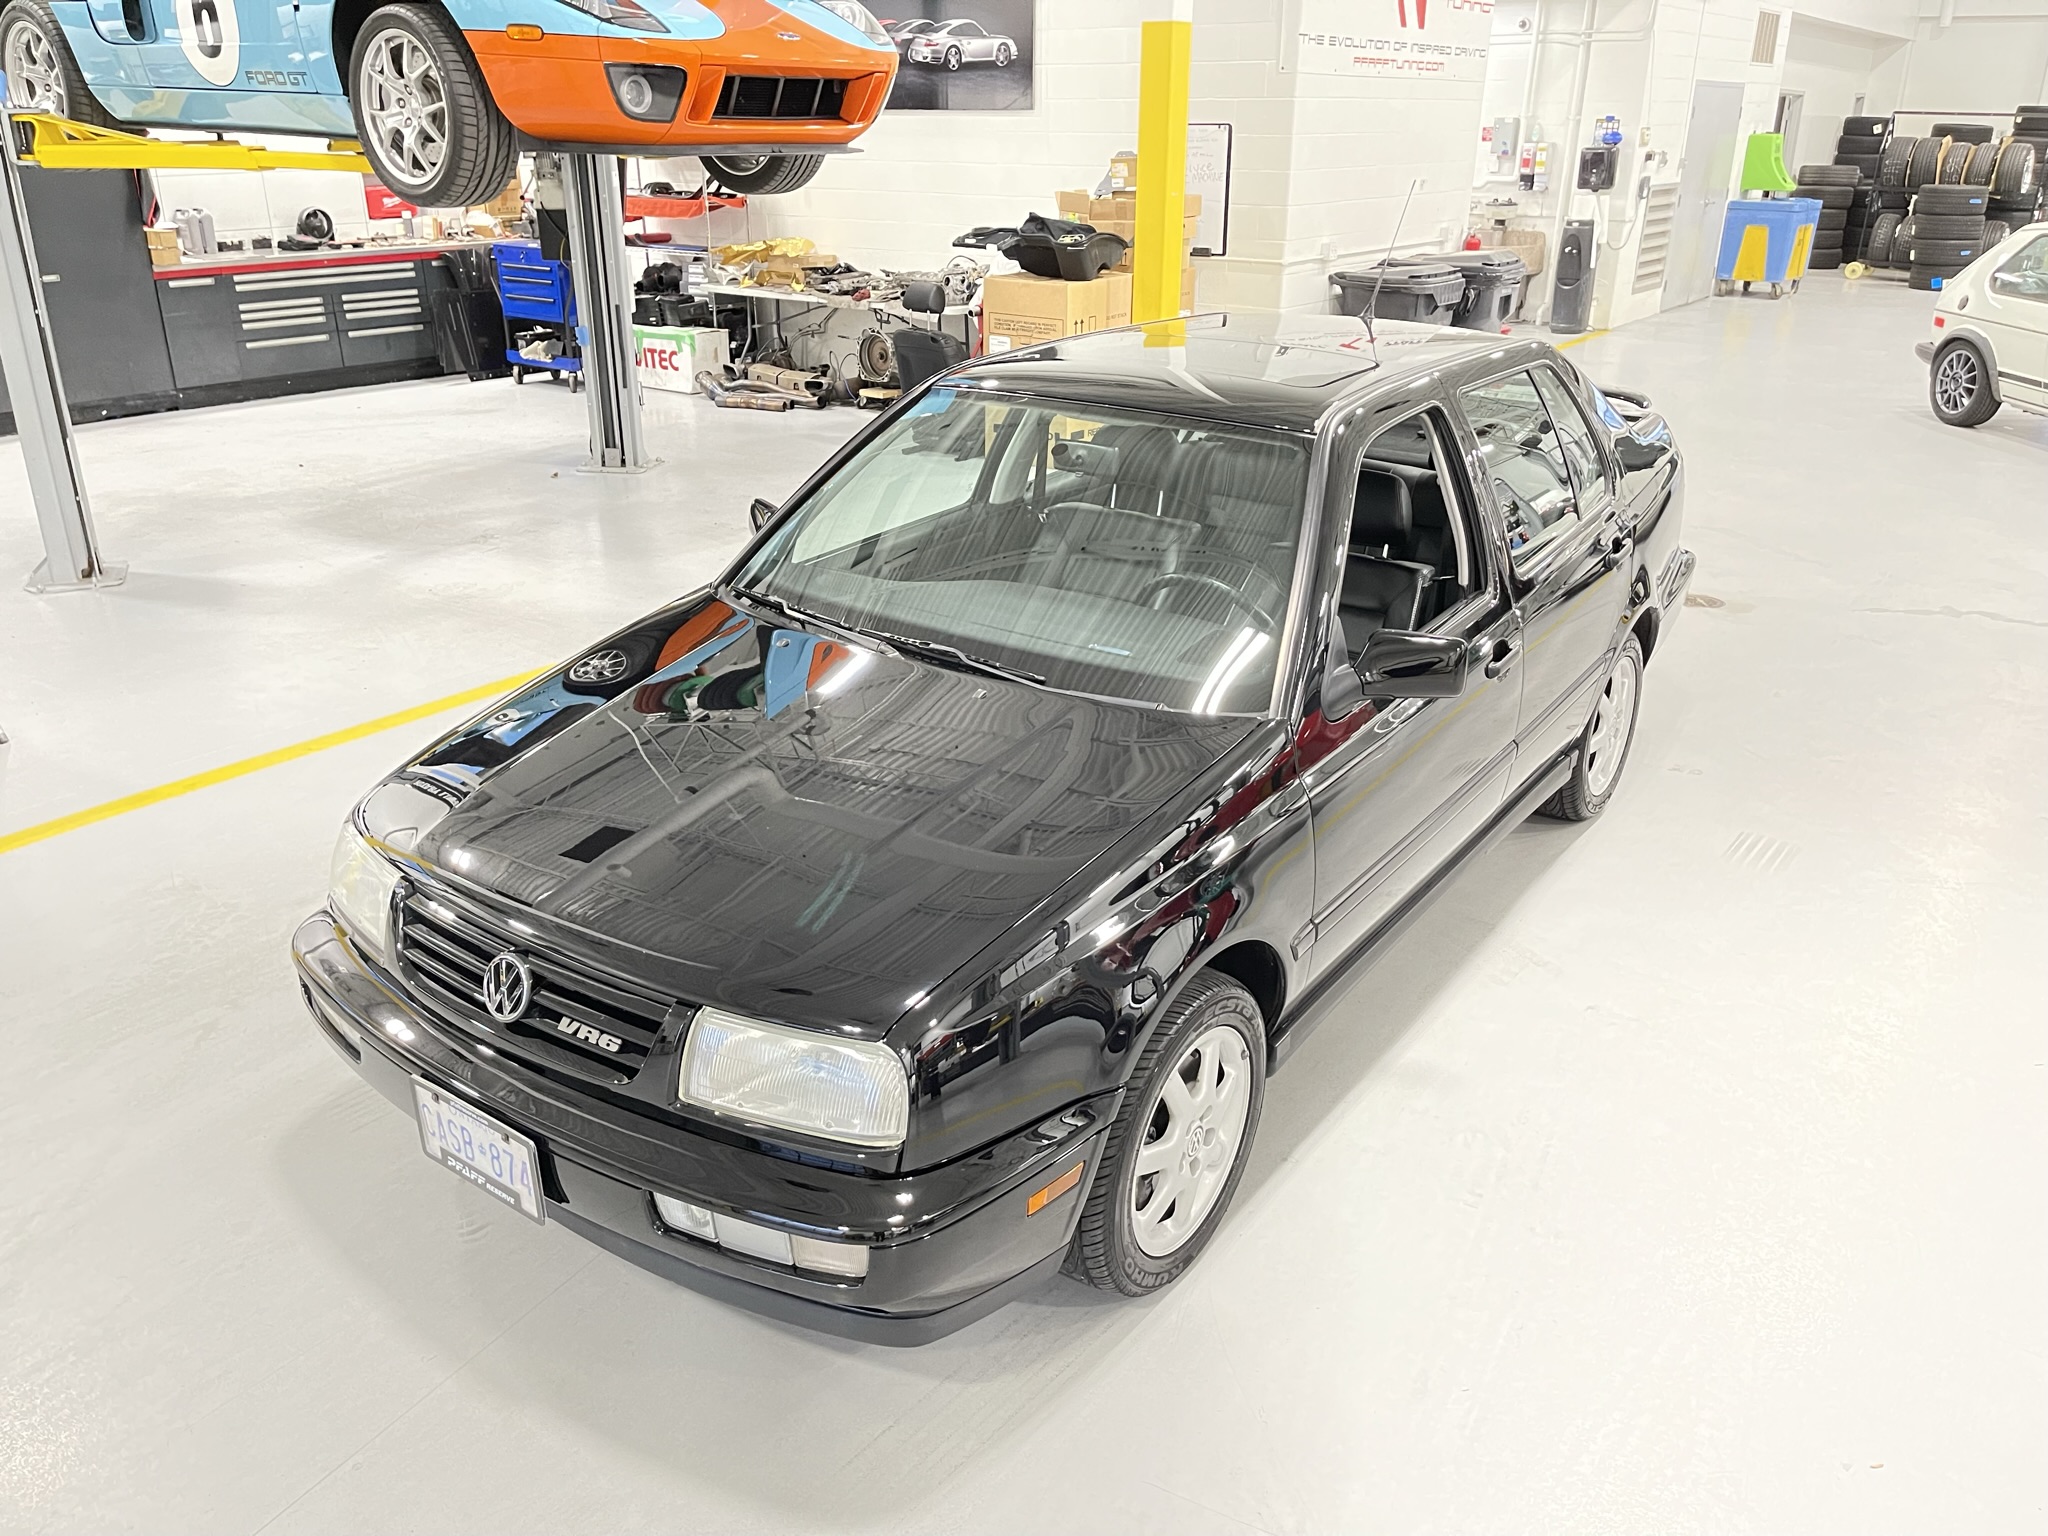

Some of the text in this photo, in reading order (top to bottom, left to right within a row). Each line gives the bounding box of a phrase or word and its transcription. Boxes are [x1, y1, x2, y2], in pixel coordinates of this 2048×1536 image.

[1299, 33, 1325, 45] THE
[1329, 36, 1390, 51] EVOLUTION
[1394, 42, 1408, 51] OF
[1454, 47, 1486, 58] DRIVING
[245, 71, 308, 87] FORD GT
[557, 1016, 623, 1053] VR6
[421, 1103, 475, 1162] CASB
[489, 1142, 532, 1197] 874
[447, 1156, 515, 1205] PFAFF RESERVE
[1124, 1256, 1184, 1287] KUMHO
